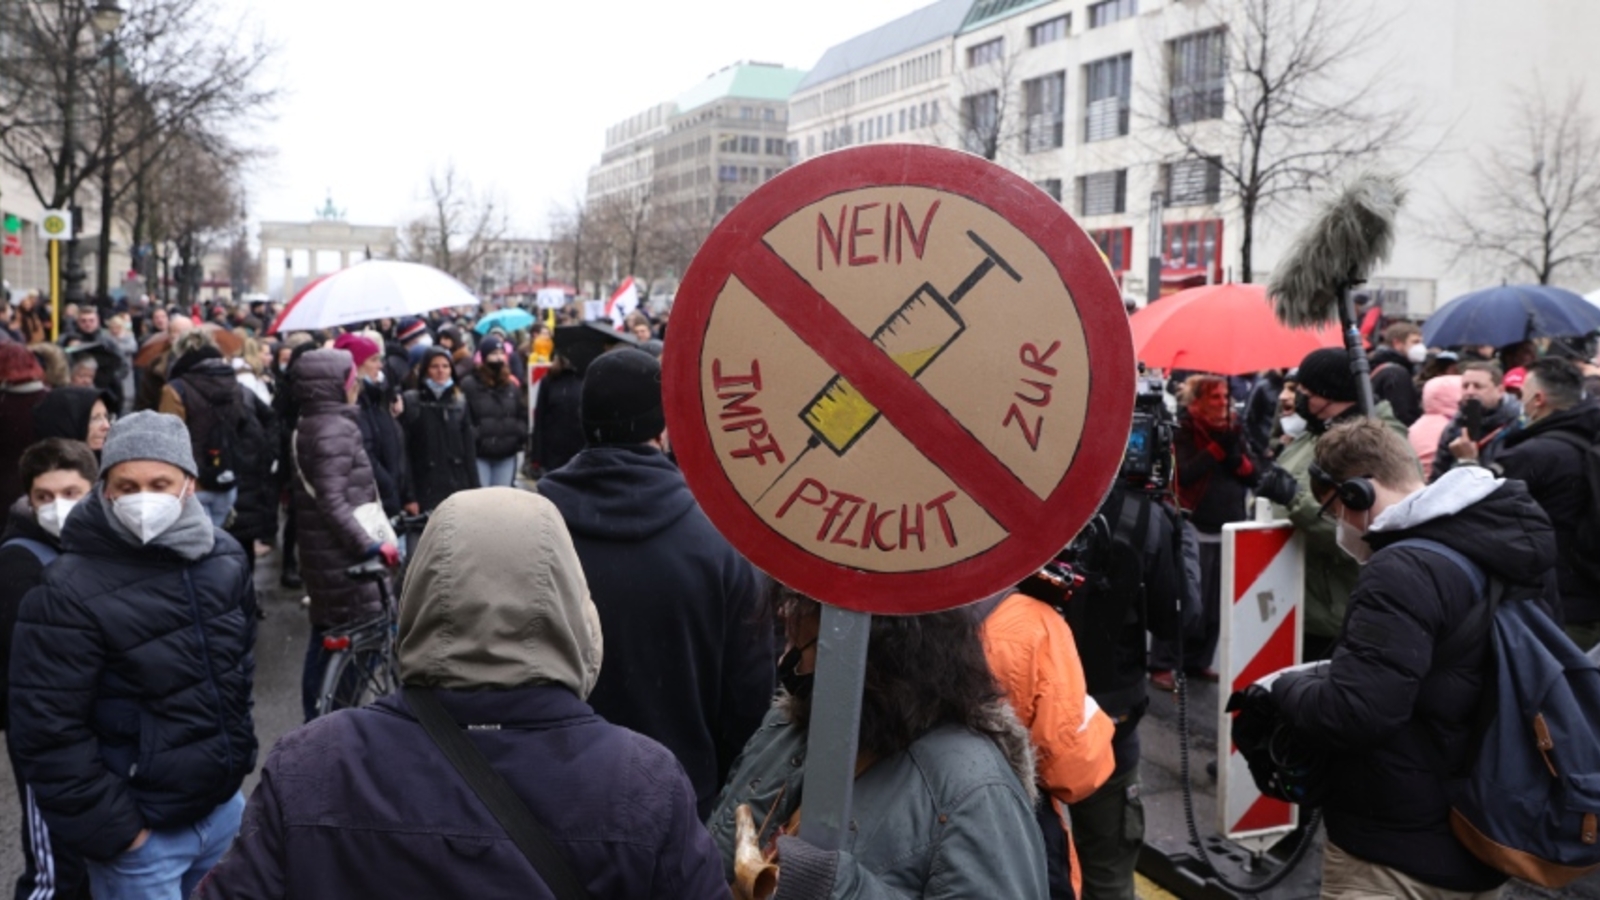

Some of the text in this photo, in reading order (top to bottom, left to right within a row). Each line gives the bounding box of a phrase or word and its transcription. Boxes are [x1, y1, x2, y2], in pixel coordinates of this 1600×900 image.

[817, 199, 941, 271] NEIN
[712, 358, 785, 466] IMPF
[1002, 340, 1061, 452] ZUR
[774, 477, 959, 552] PFLICHT
